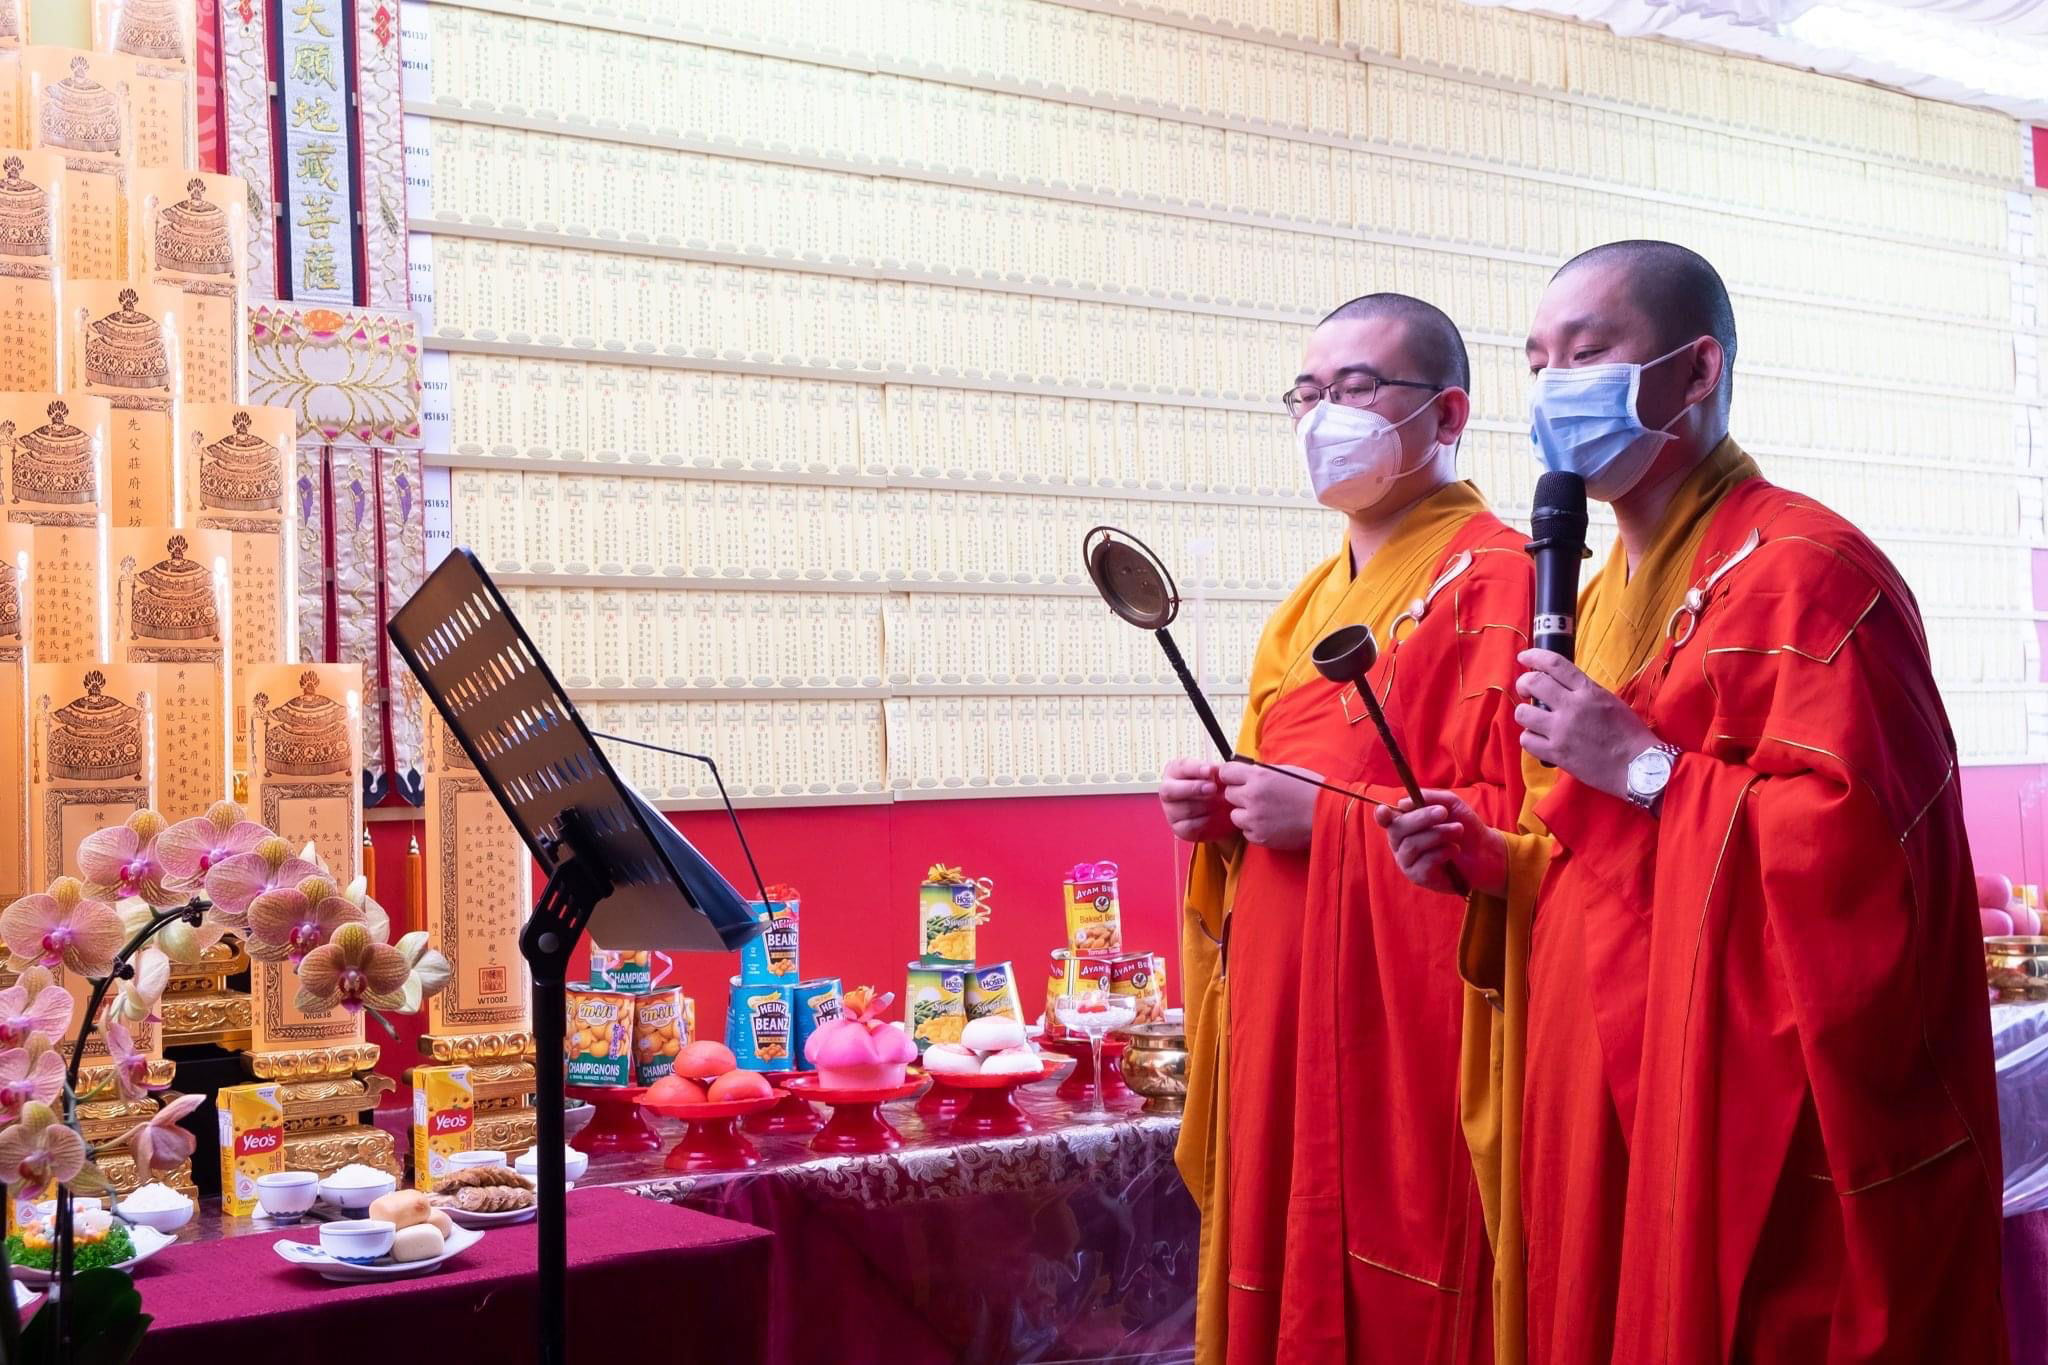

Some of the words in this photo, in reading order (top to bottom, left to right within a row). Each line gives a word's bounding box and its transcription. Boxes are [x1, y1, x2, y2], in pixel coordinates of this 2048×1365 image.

[290, 0, 340, 291] 大願地藏菩薩
[406, 177, 431, 187] S1491
[1535, 617, 1551, 631] IC
[1558, 616, 1567, 631] 3
[1076, 887, 1099, 899] AYAM
[767, 933, 798, 946] BEANZ
[1114, 965, 1135, 978] AYAM
[983, 977, 1006, 988] HOSEN
[478, 996, 508, 1005] WT0082
[760, 1004, 785, 1014] HEINZ
[755, 1017, 788, 1030] BEANZ
[568, 1062, 620, 1076] CHAMPIGNONS
[436, 1114, 467, 1131] Yeo's
[243, 1134, 277, 1151] Yeo's
